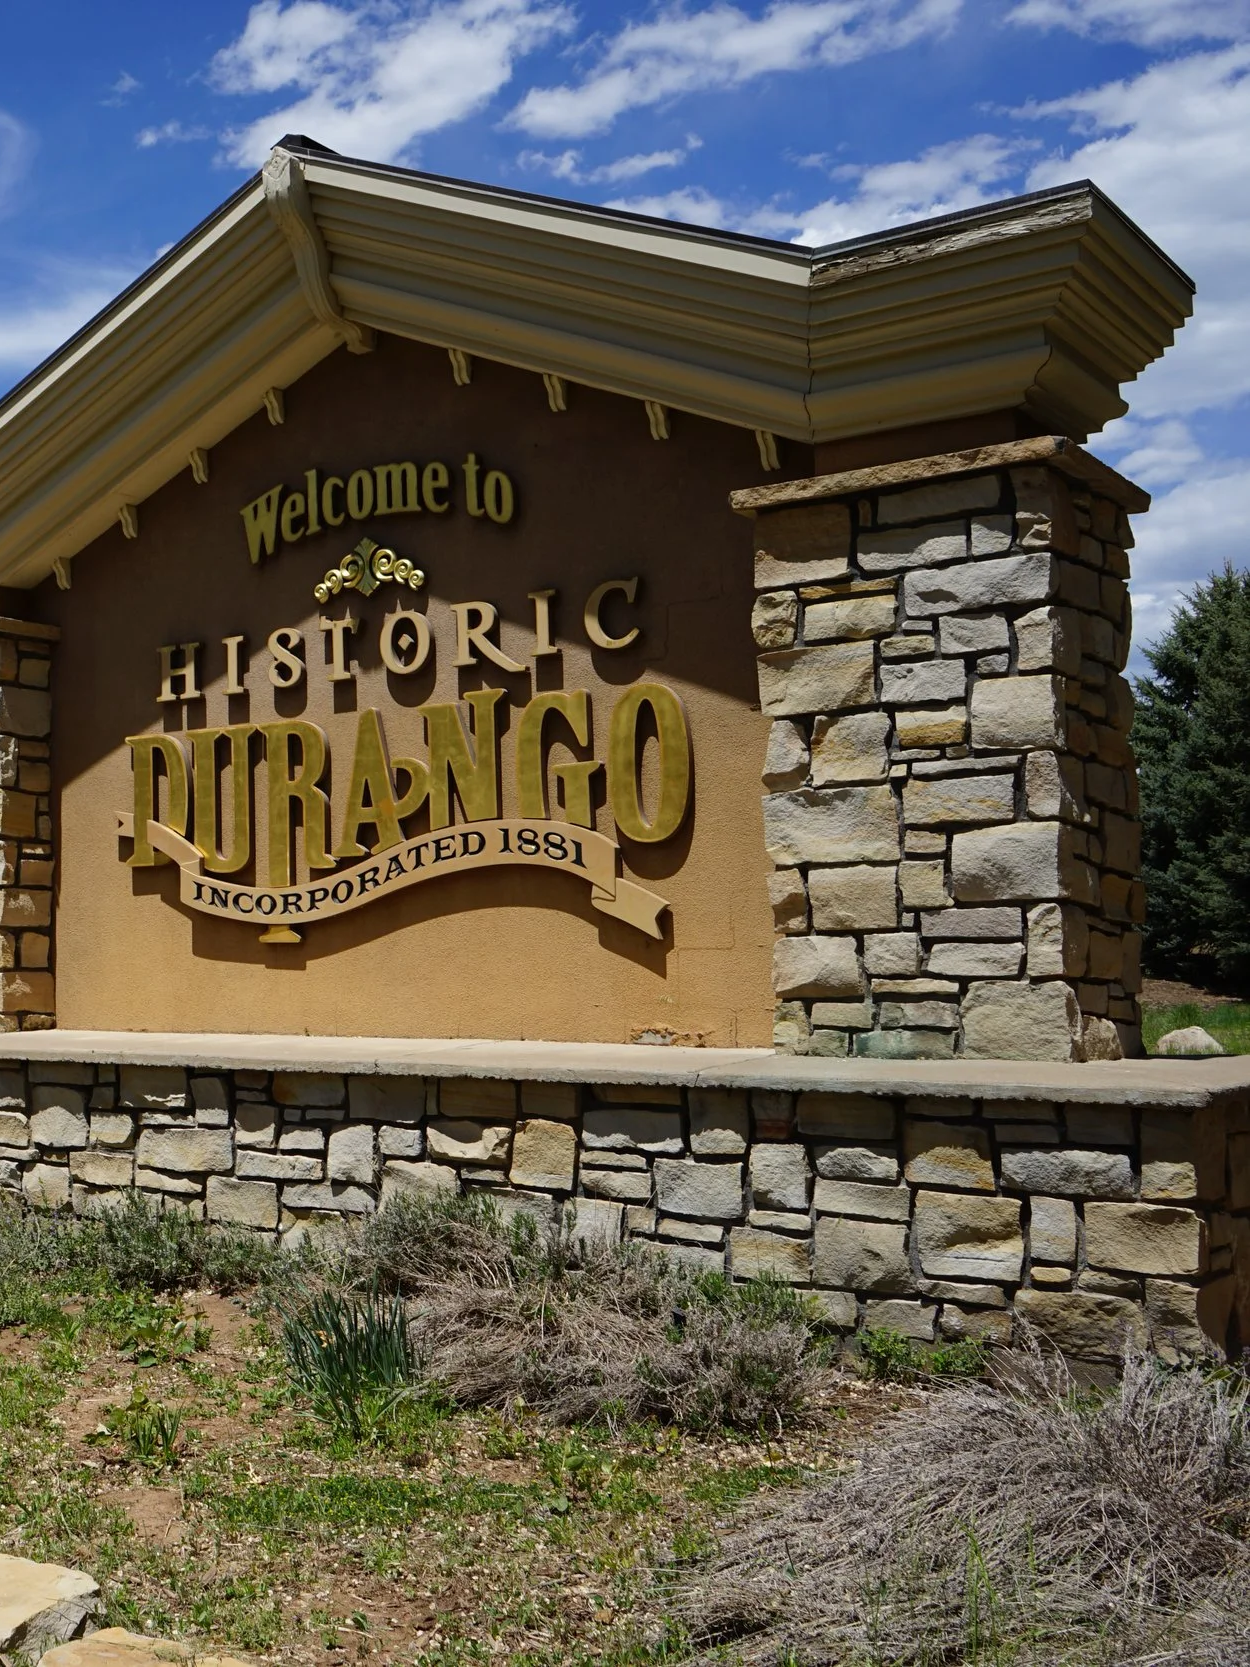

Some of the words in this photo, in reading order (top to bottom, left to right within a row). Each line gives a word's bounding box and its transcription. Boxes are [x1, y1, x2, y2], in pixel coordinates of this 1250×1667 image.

[239, 461, 450, 565] Welcome
[461, 452, 514, 524] to
[156, 576, 640, 702] HISTORIC
[125, 683, 694, 943] DURANGO
[191, 827, 486, 915] INCORPORATED
[499, 827, 588, 870] 1881
